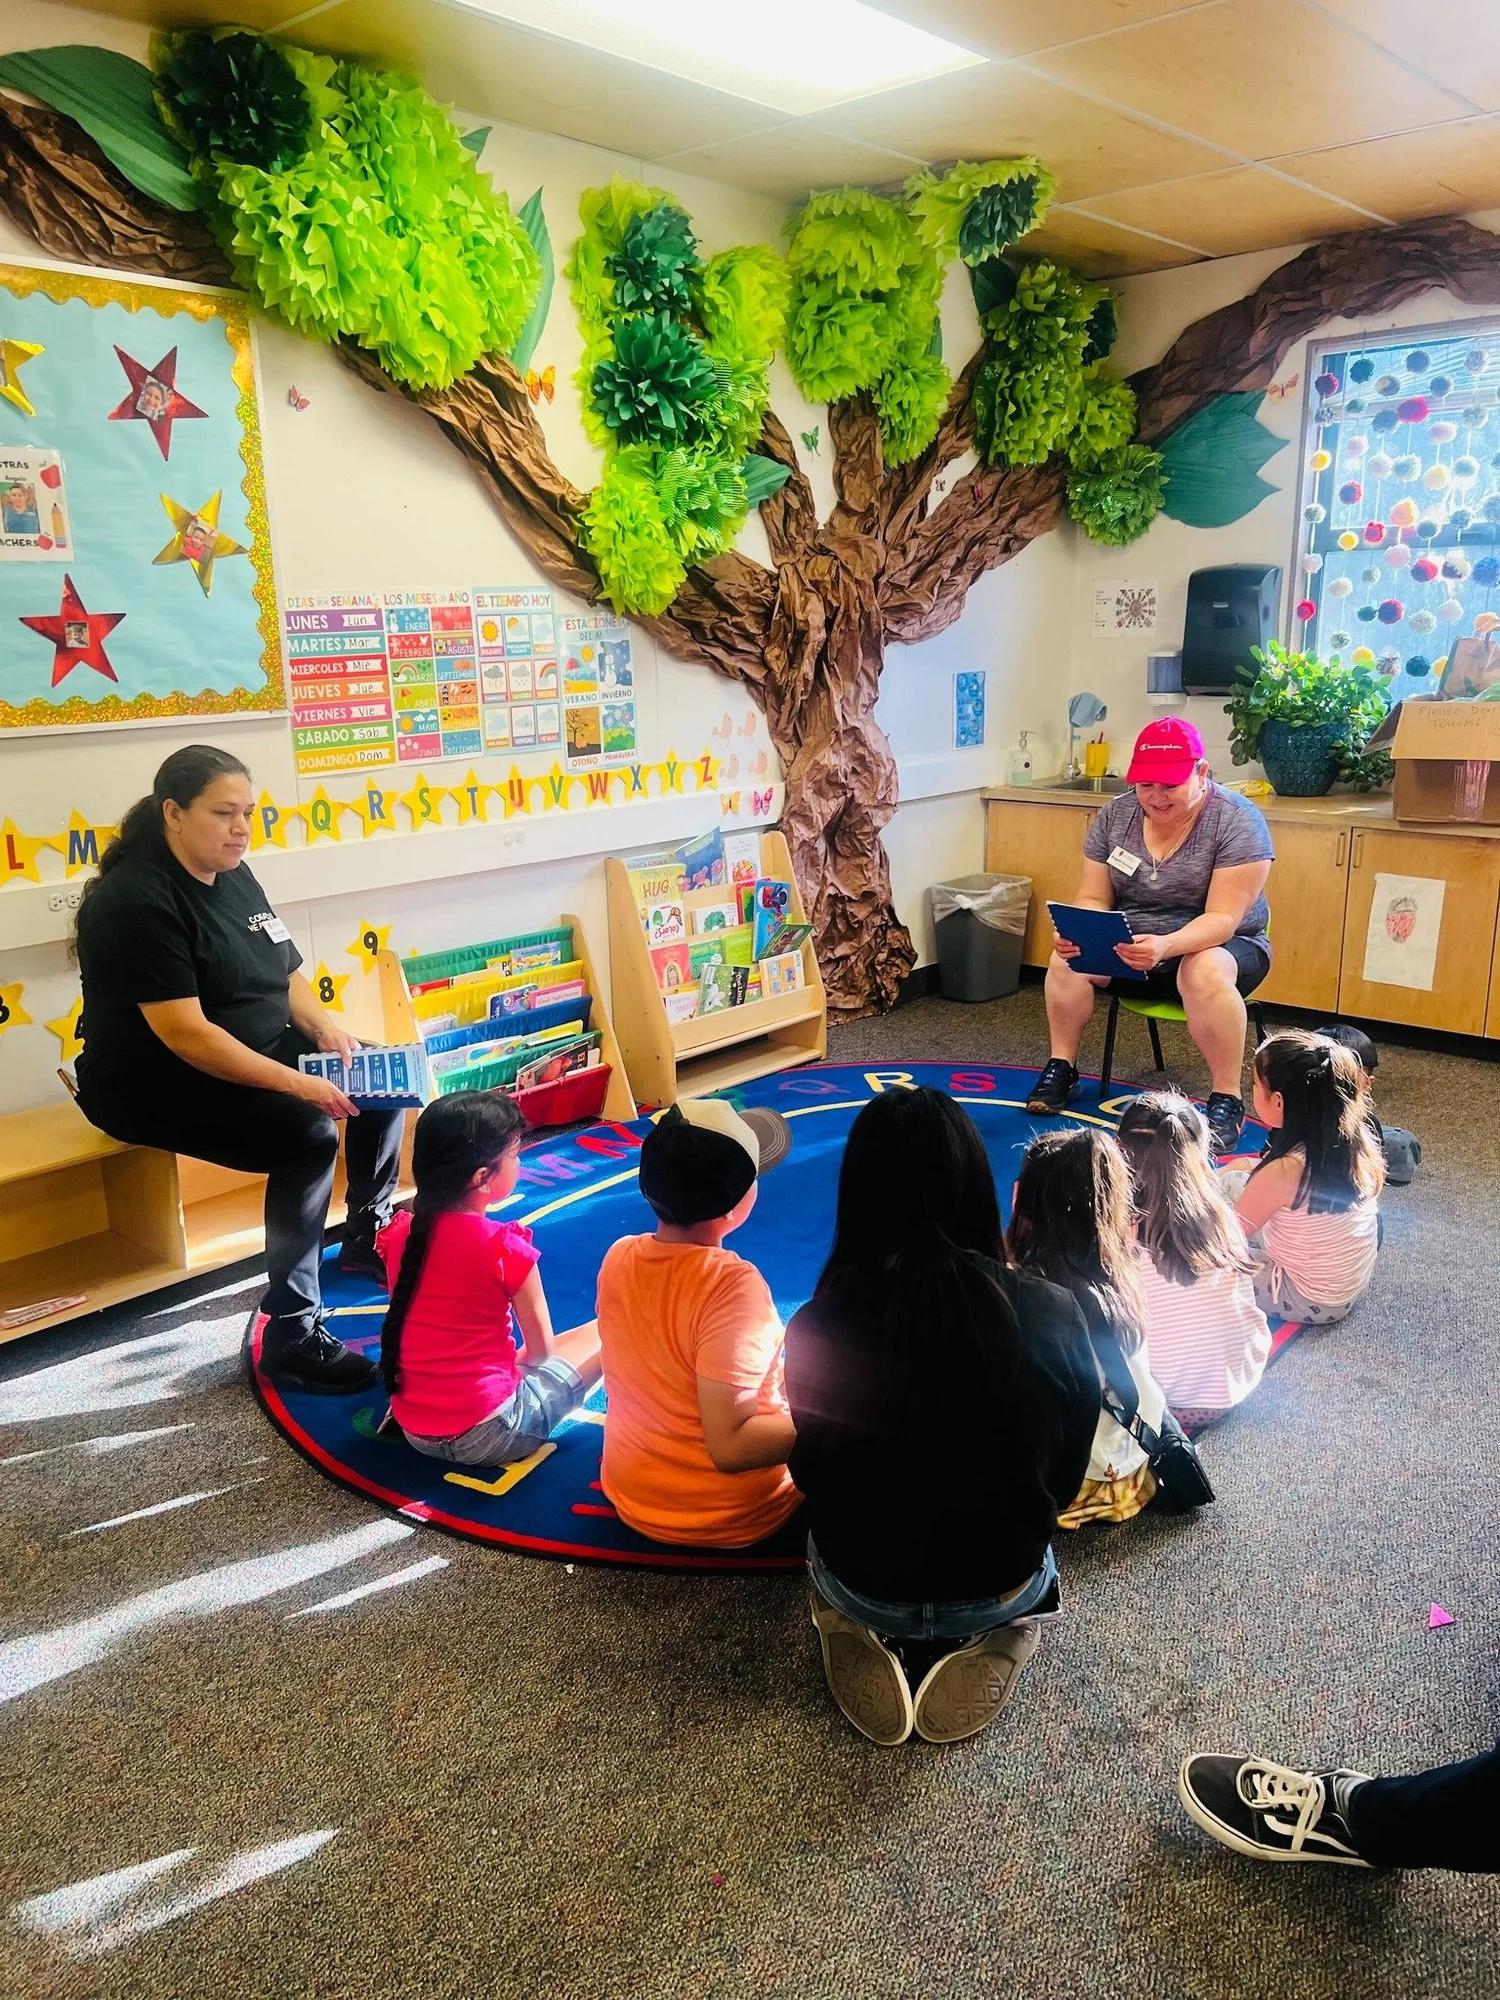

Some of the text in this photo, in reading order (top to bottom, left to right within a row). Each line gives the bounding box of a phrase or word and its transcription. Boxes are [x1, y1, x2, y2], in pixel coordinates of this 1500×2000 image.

[0, 461, 29, 469] TRAS
[331, 595, 373, 607] SEMANA
[384, 594, 402, 605] LOS
[405, 593, 437, 605] MESES
[449, 591, 469, 603] AÑO
[476, 594, 550, 607] EL TIEMPO HOY
[285, 614, 329, 630] LUNES
[347, 616, 367, 626] Lun
[404, 621, 429, 631] ENERO
[453, 621, 472, 630] JULIO
[287, 637, 341, 653] MARTES
[349, 638, 371, 648] Mar
[400, 648, 432, 657] FEBRERO
[448, 645, 474, 655] AGOSTO
[409, 673, 434, 682] MARZO
[437, 670, 476, 680] SEPTIEMBRE
[292, 684, 342, 699] JUEVES
[355, 684, 374, 693] Jue
[601, 689, 632, 699] INVIERNO
[450, 695, 478, 705] OCTUBRE
[565, 694, 598, 705] VERANO
[294, 707, 347, 723] VIERNES
[358, 707, 375, 716] Vie
[419, 722, 438, 732] MAYO
[297, 728, 350, 746] SÁBADO
[358, 729, 380, 739] Sab
[419, 748, 440, 757] JUNIO
[447, 744, 480, 755] DICIEMBRE
[299, 753, 355, 769] DOMINGO
[359, 751, 383, 761] Dom
[571, 755, 598, 767] OTOÑO
[605, 751, 635, 761] PRIMAVERA
[261, 756, 713, 838] P Q R S T U V W X Y Z
[6, 829, 100, 870] L M
[643, 880, 670, 898] HUG
[363, 931, 379, 956] 9
[319, 976, 335, 1003] 8
[778, 1079, 851, 1094] Q
[863, 1071, 919, 1092] R
[949, 1072, 997, 1092] S
